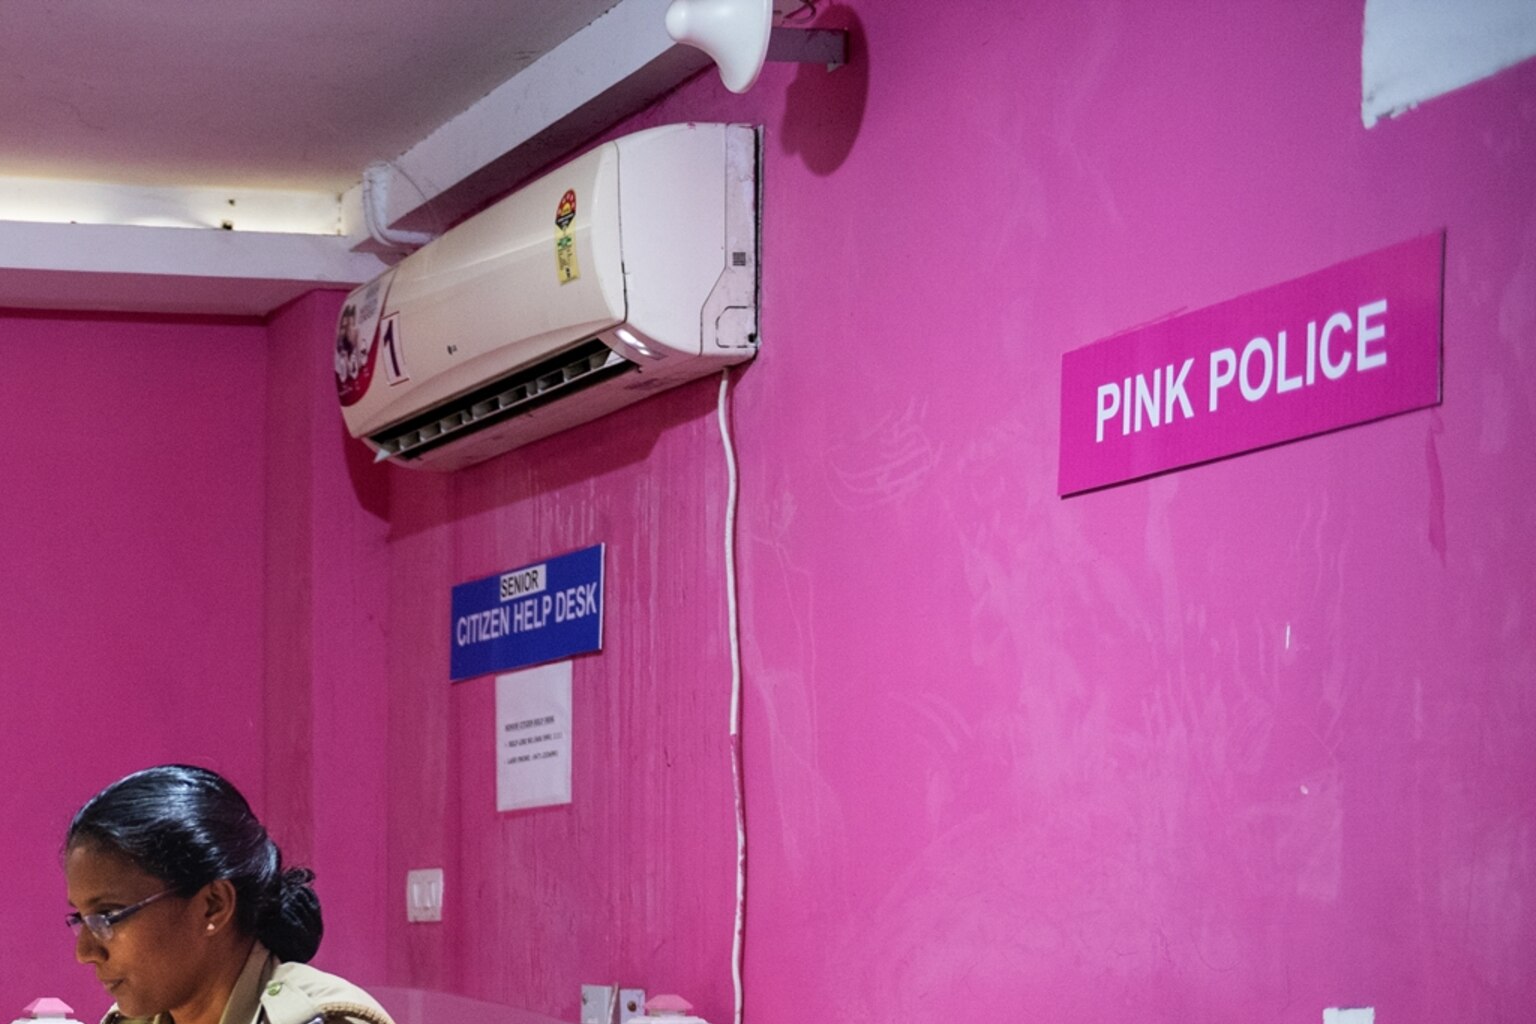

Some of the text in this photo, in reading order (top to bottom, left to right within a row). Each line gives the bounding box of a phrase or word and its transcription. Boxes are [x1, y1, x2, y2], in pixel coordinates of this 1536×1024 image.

[383, 319, 401, 377] 1
[1095, 298, 1388, 443] PINK POLICE
[456, 581, 597, 647] CITIZEN HELP DESK
[501, 569, 539, 598] SENIOR
